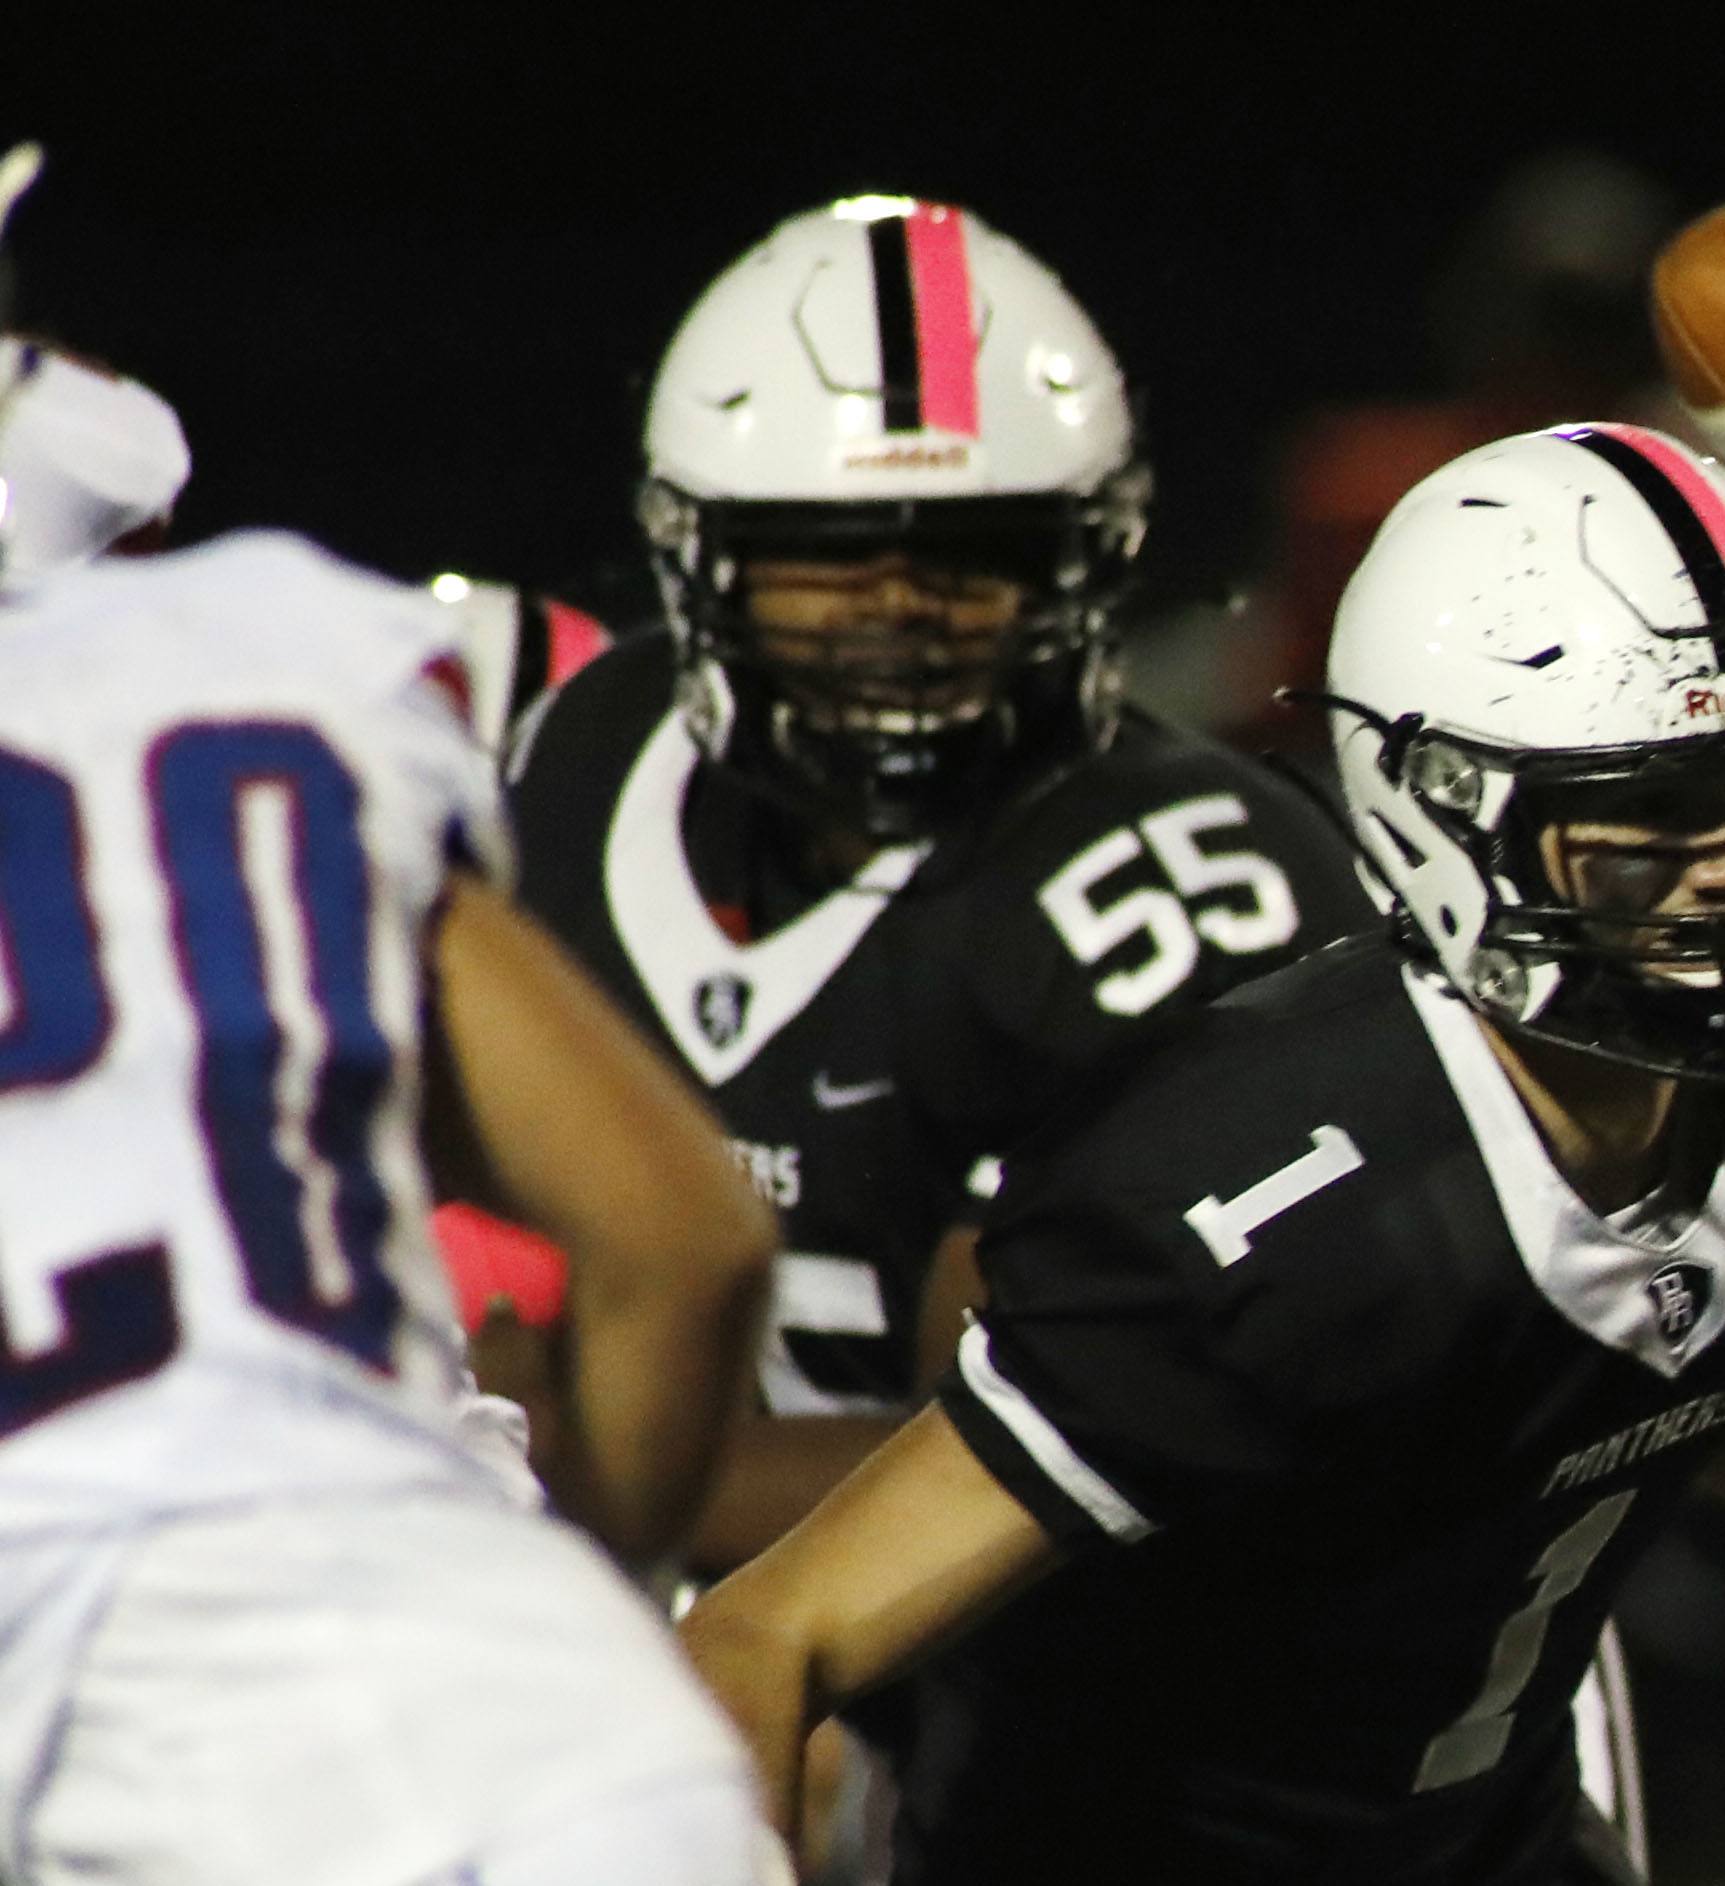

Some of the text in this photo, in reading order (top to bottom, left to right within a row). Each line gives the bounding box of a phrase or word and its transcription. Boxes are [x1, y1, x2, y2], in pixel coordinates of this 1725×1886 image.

[1037, 795, 1299, 1016] 55
[1183, 1123, 1365, 1269] 1
[1409, 1487, 1640, 1796] 1
